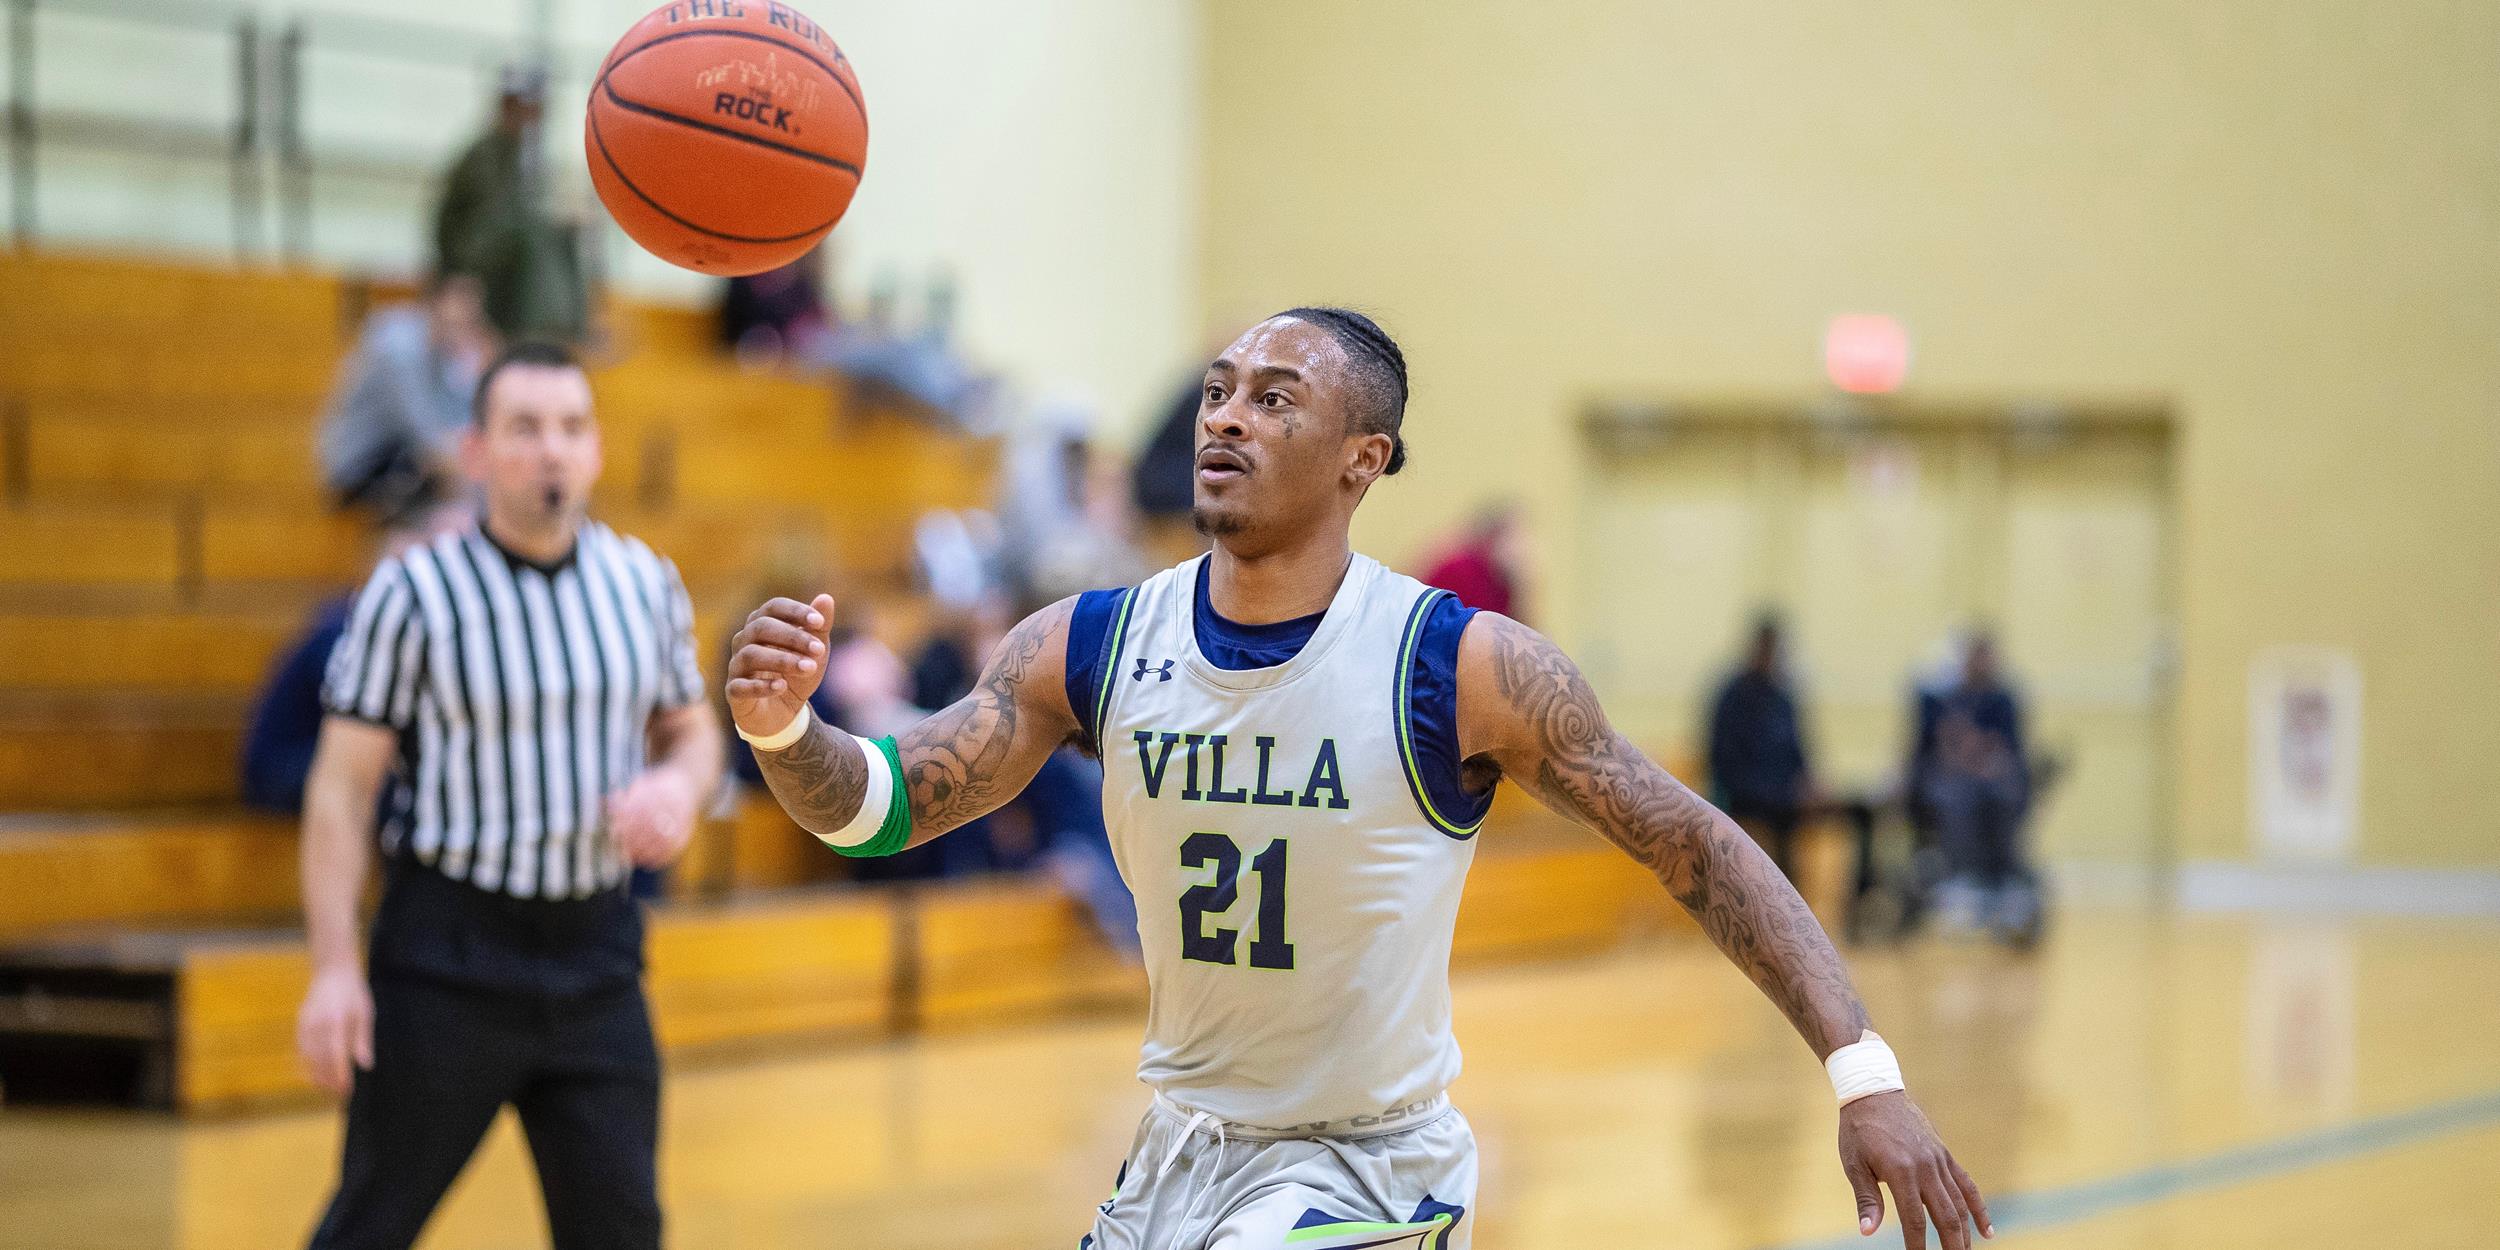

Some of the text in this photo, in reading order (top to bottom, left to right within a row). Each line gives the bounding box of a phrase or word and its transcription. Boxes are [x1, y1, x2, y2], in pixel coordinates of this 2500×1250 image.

[665, 0, 745, 23] THE
[1132, 730, 1350, 810] VILLA
[1178, 831, 1296, 970] 21
